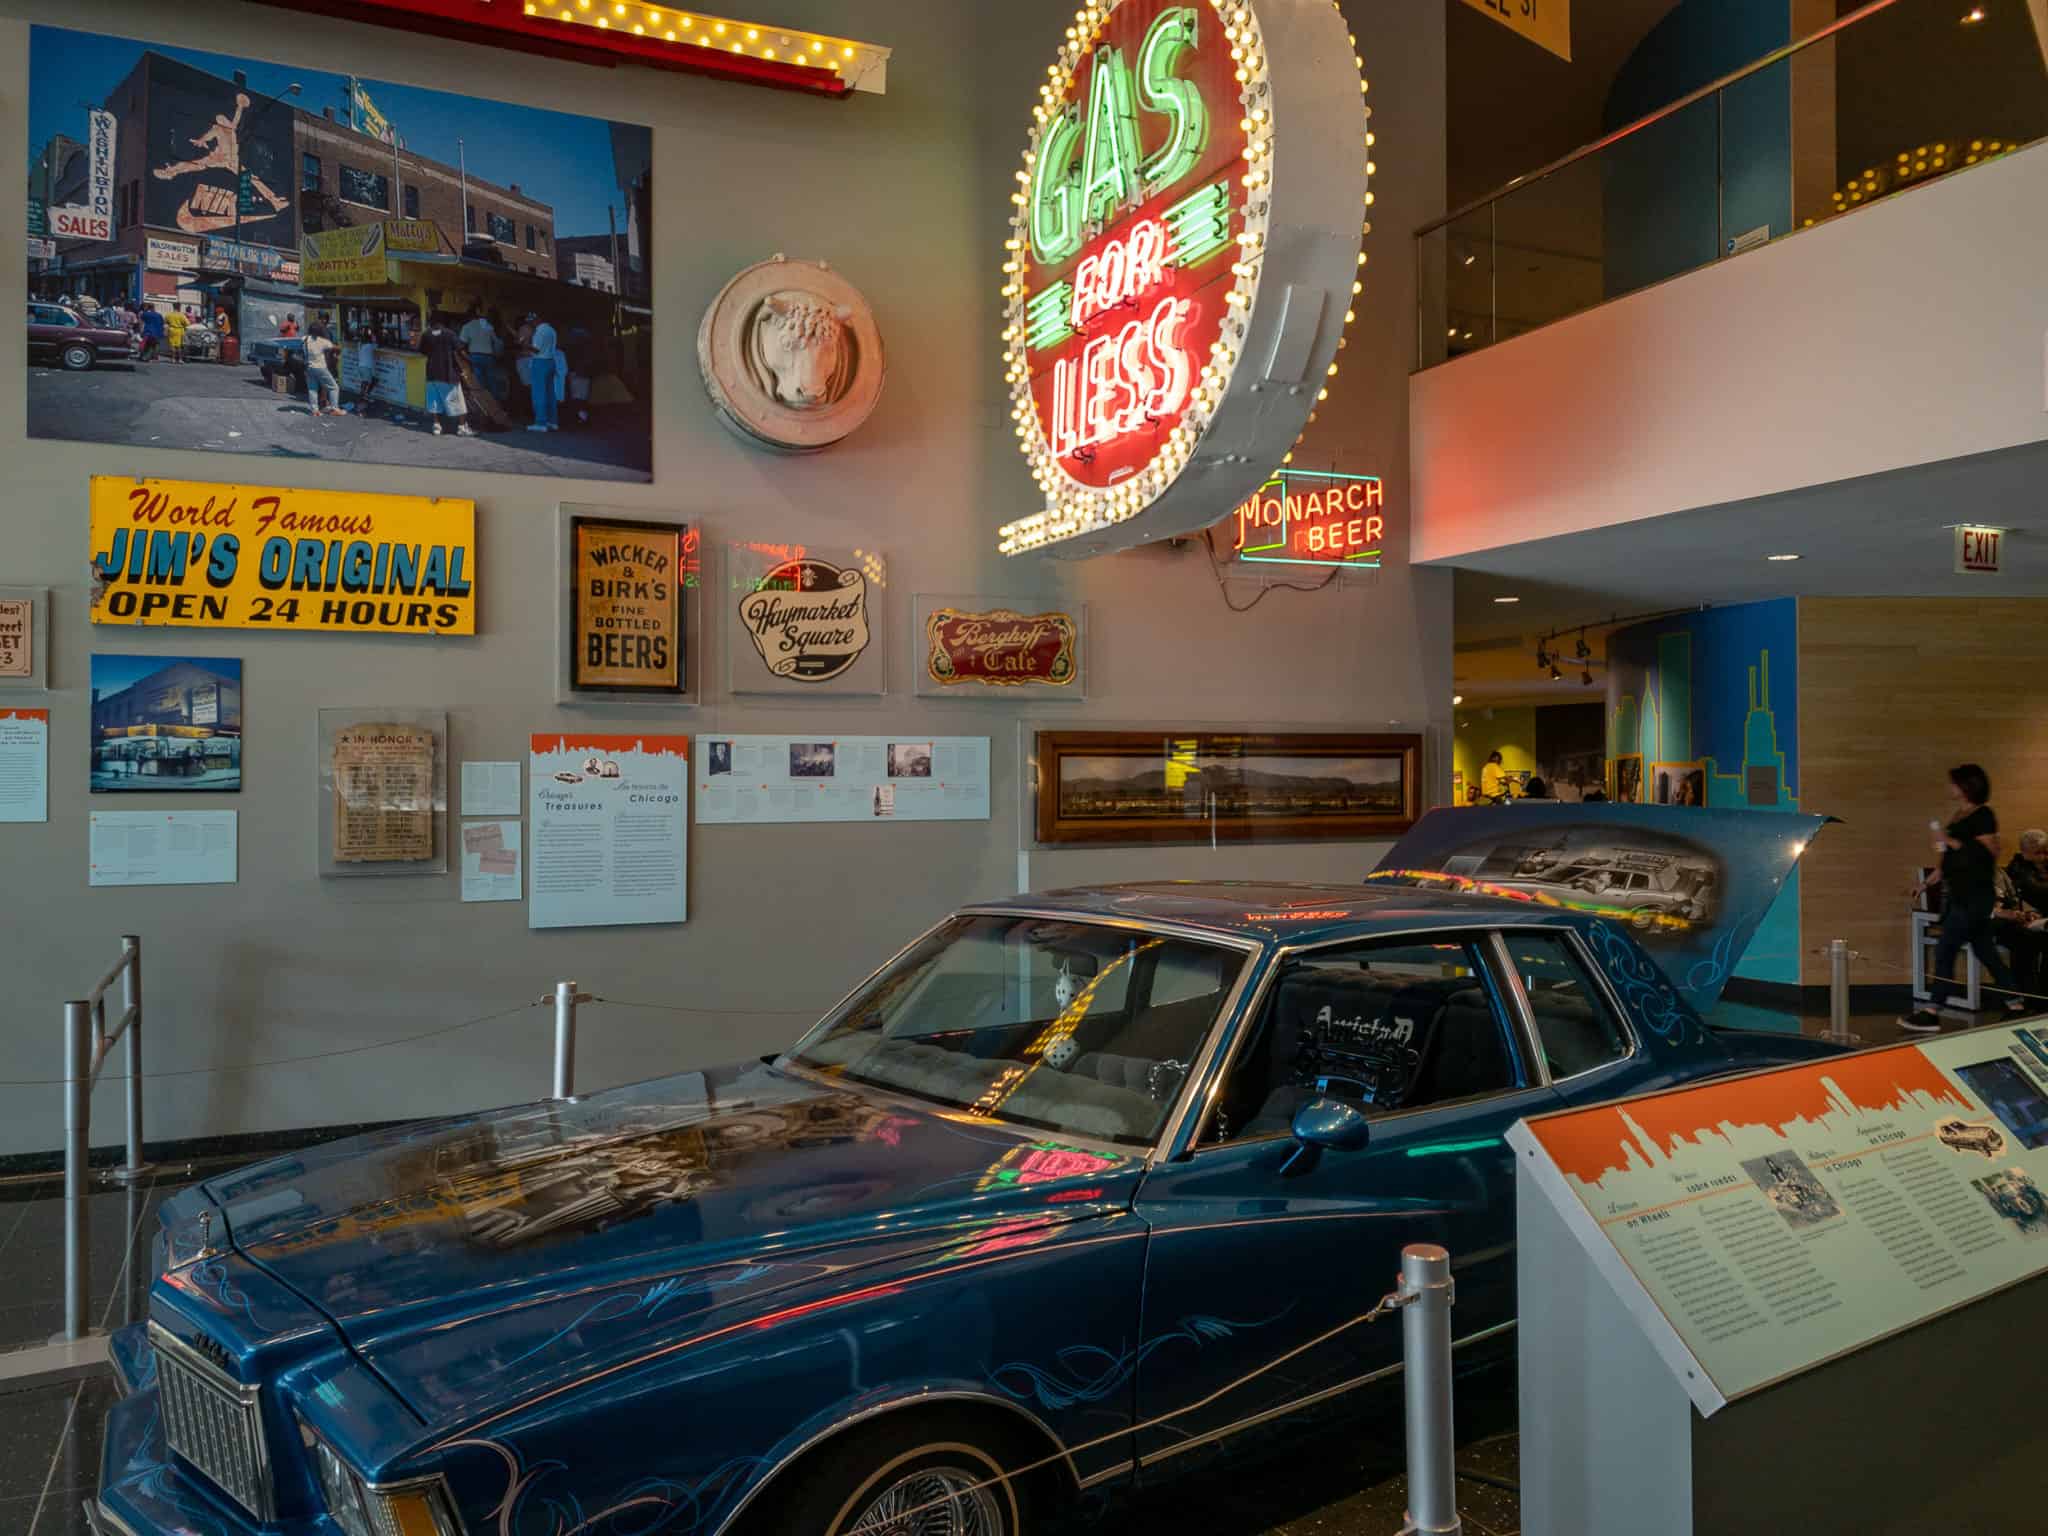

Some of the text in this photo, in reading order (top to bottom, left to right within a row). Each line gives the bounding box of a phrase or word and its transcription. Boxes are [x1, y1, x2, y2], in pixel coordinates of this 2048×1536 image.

[1031, 7, 1207, 264] GAS
[94, 115, 112, 216] WASHINGTON
[57, 214, 109, 239] SALES
[157, 250, 189, 262] SALES
[1071, 219, 1177, 326] FOR
[1052, 297, 1194, 459] LESS
[129, 488, 373, 536] World Famous
[1233, 479, 1383, 550] MONARCH
[1308, 516, 1384, 552] BEER
[1963, 531, 2000, 564] EXIT
[96, 527, 473, 598] JIM'S ORIGINAL
[590, 544, 669, 574] WACKER
[623, 566, 634, 578] &
[591, 578, 667, 601] BIRK'S
[108, 591, 460, 628] OPEN 24 HOURS
[595, 616, 661, 630] BOTTLED
[612, 605, 645, 616] FINE
[748, 593, 861, 635] Haymarket
[588, 632, 667, 669] BEERS
[779, 625, 855, 653] Square
[951, 622, 1050, 651] Berghoff
[545, 801, 602, 811] Treasures
[630, 794, 679, 804] Chicago
